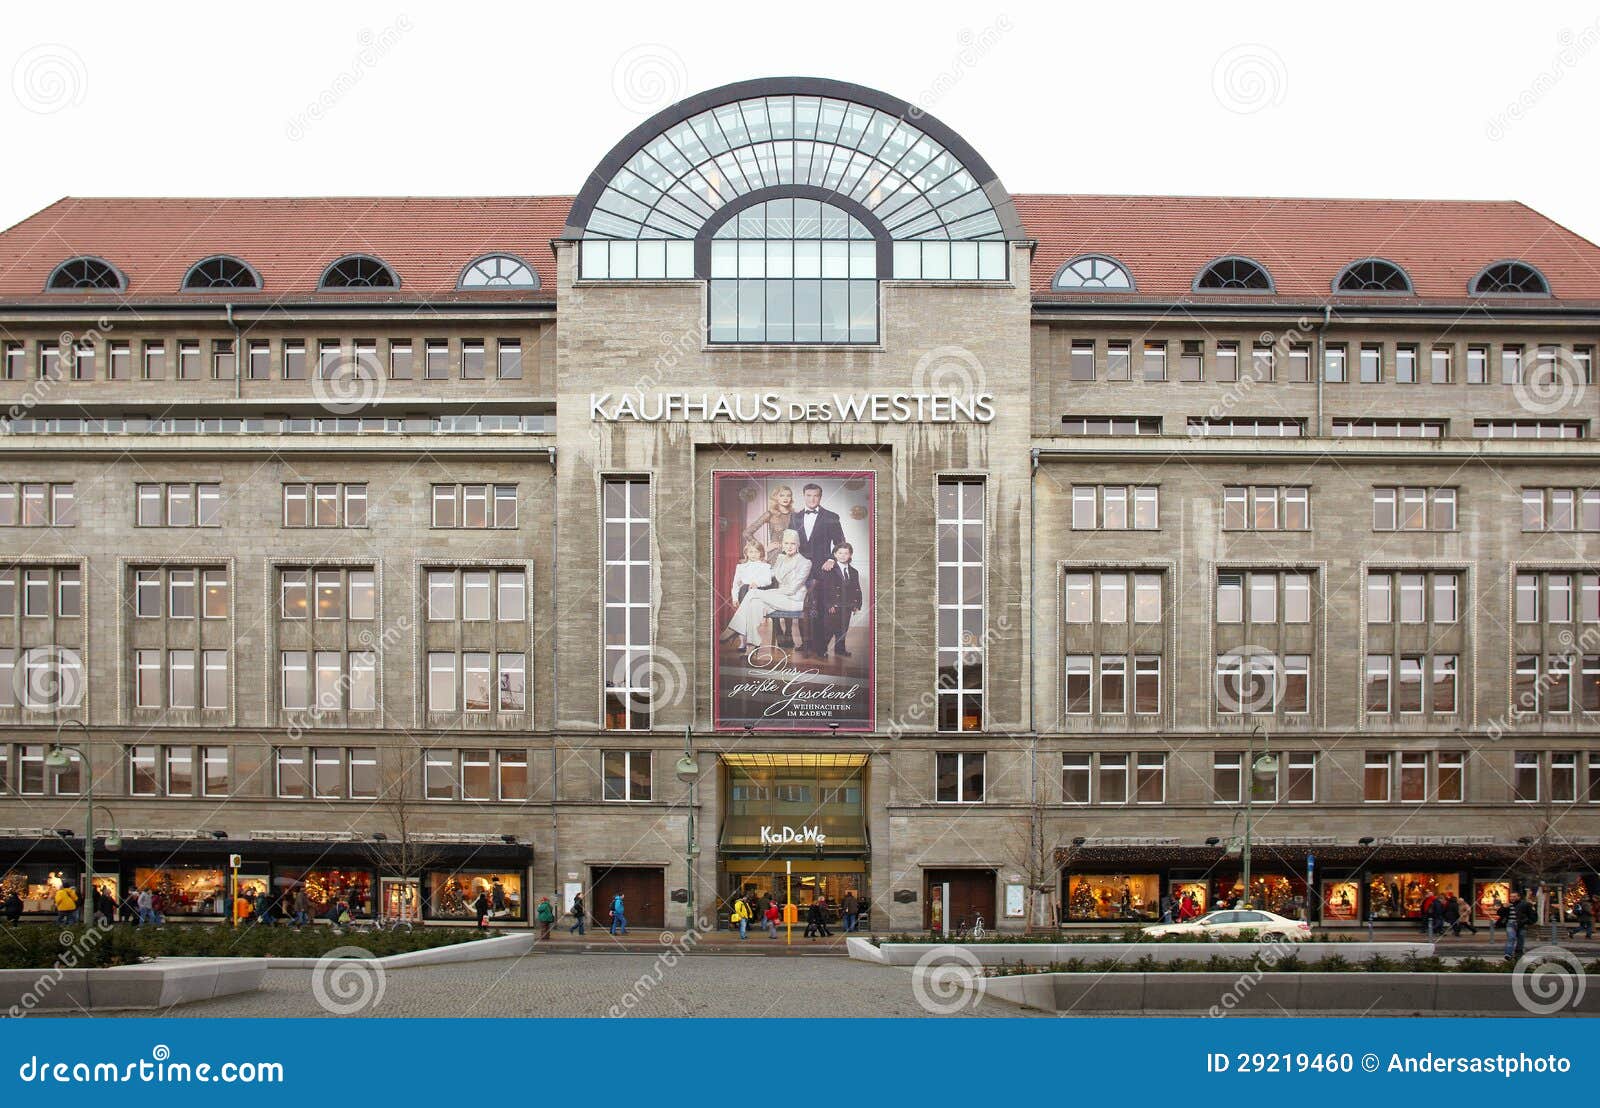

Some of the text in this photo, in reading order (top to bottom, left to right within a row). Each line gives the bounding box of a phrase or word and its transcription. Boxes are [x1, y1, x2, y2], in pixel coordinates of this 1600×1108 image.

[590, 391, 995, 422] KAUFHAUS DES WESTENS
[748, 645, 801, 675] Das
[728, 669, 860, 716] größte Geschenk
[793, 703, 852, 711] WEIHNACHTEN
[760, 825, 827, 844] KaDeWe
